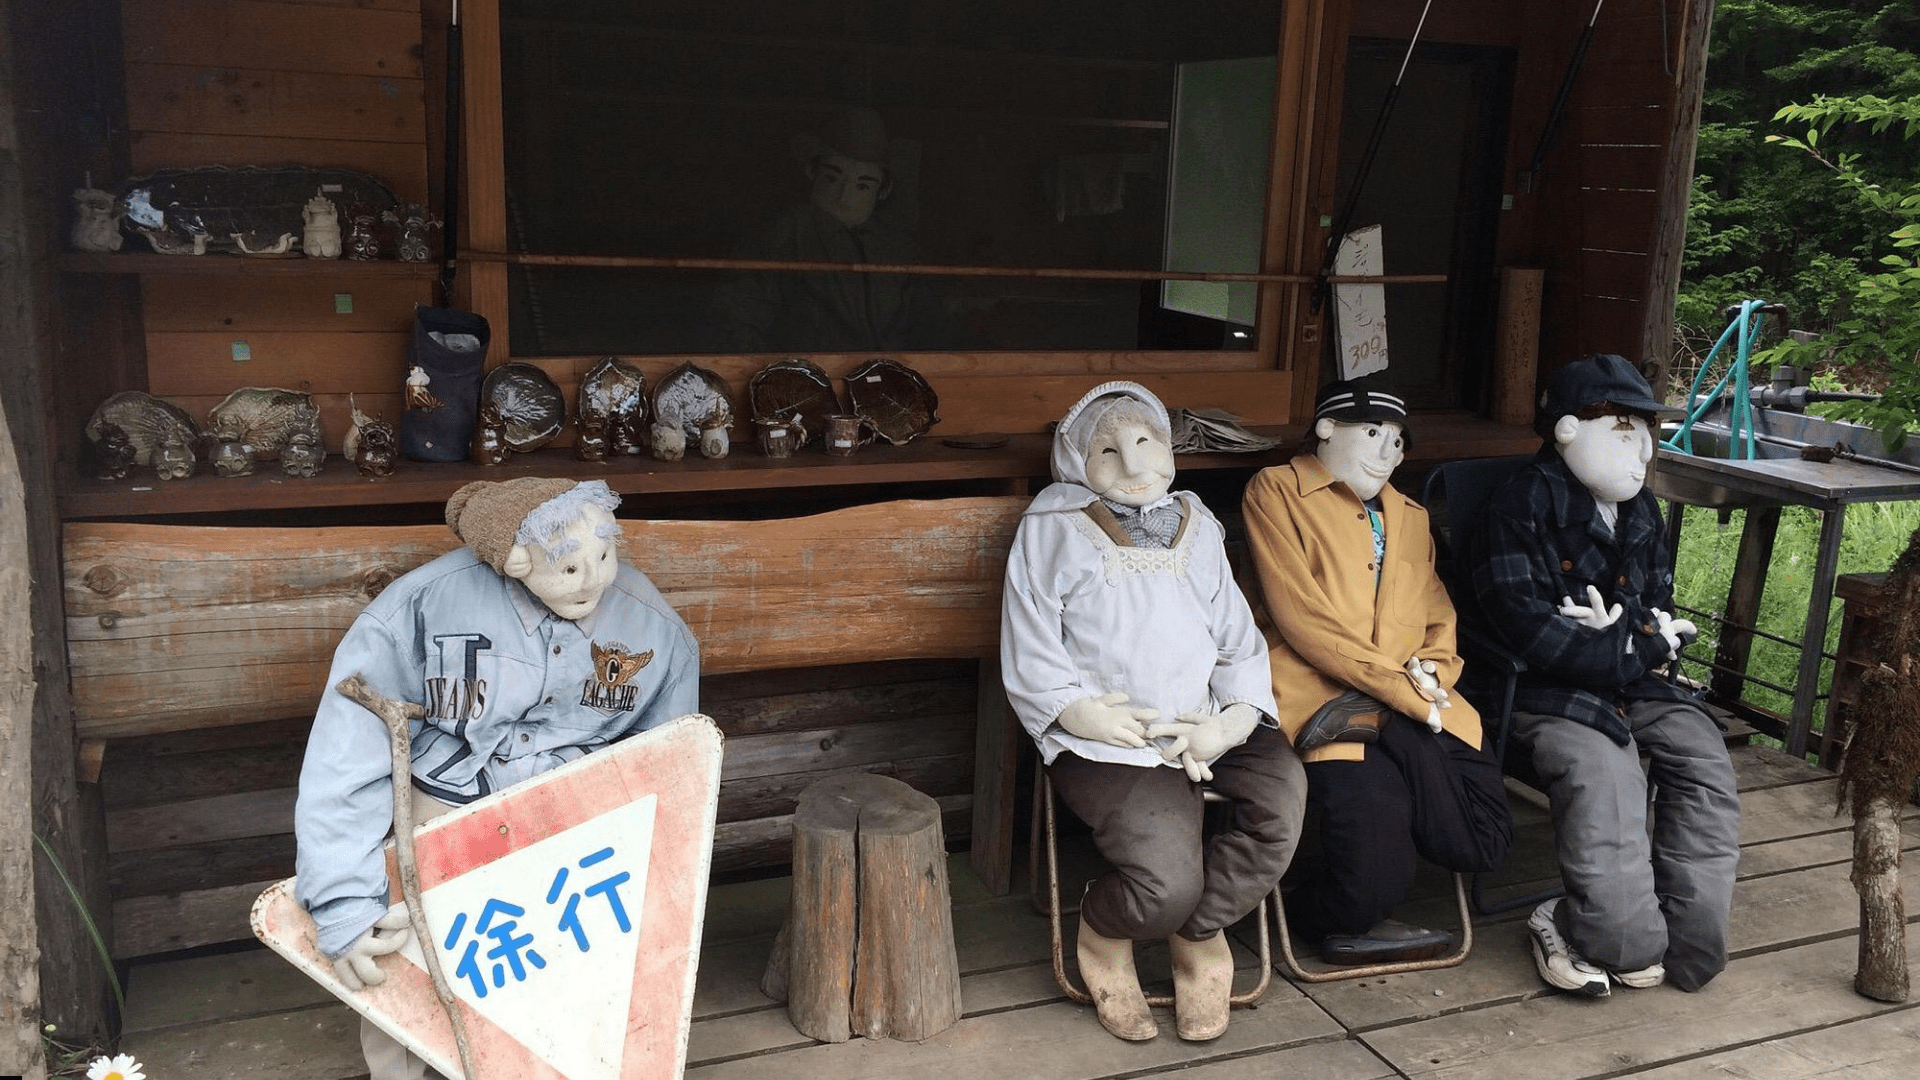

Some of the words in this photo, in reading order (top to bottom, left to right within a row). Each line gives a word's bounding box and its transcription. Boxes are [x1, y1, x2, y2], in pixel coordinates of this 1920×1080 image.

[425, 677, 487, 721] JEANS
[579, 679, 639, 712] LAGACHE
[444, 847, 632, 998] 徐行
